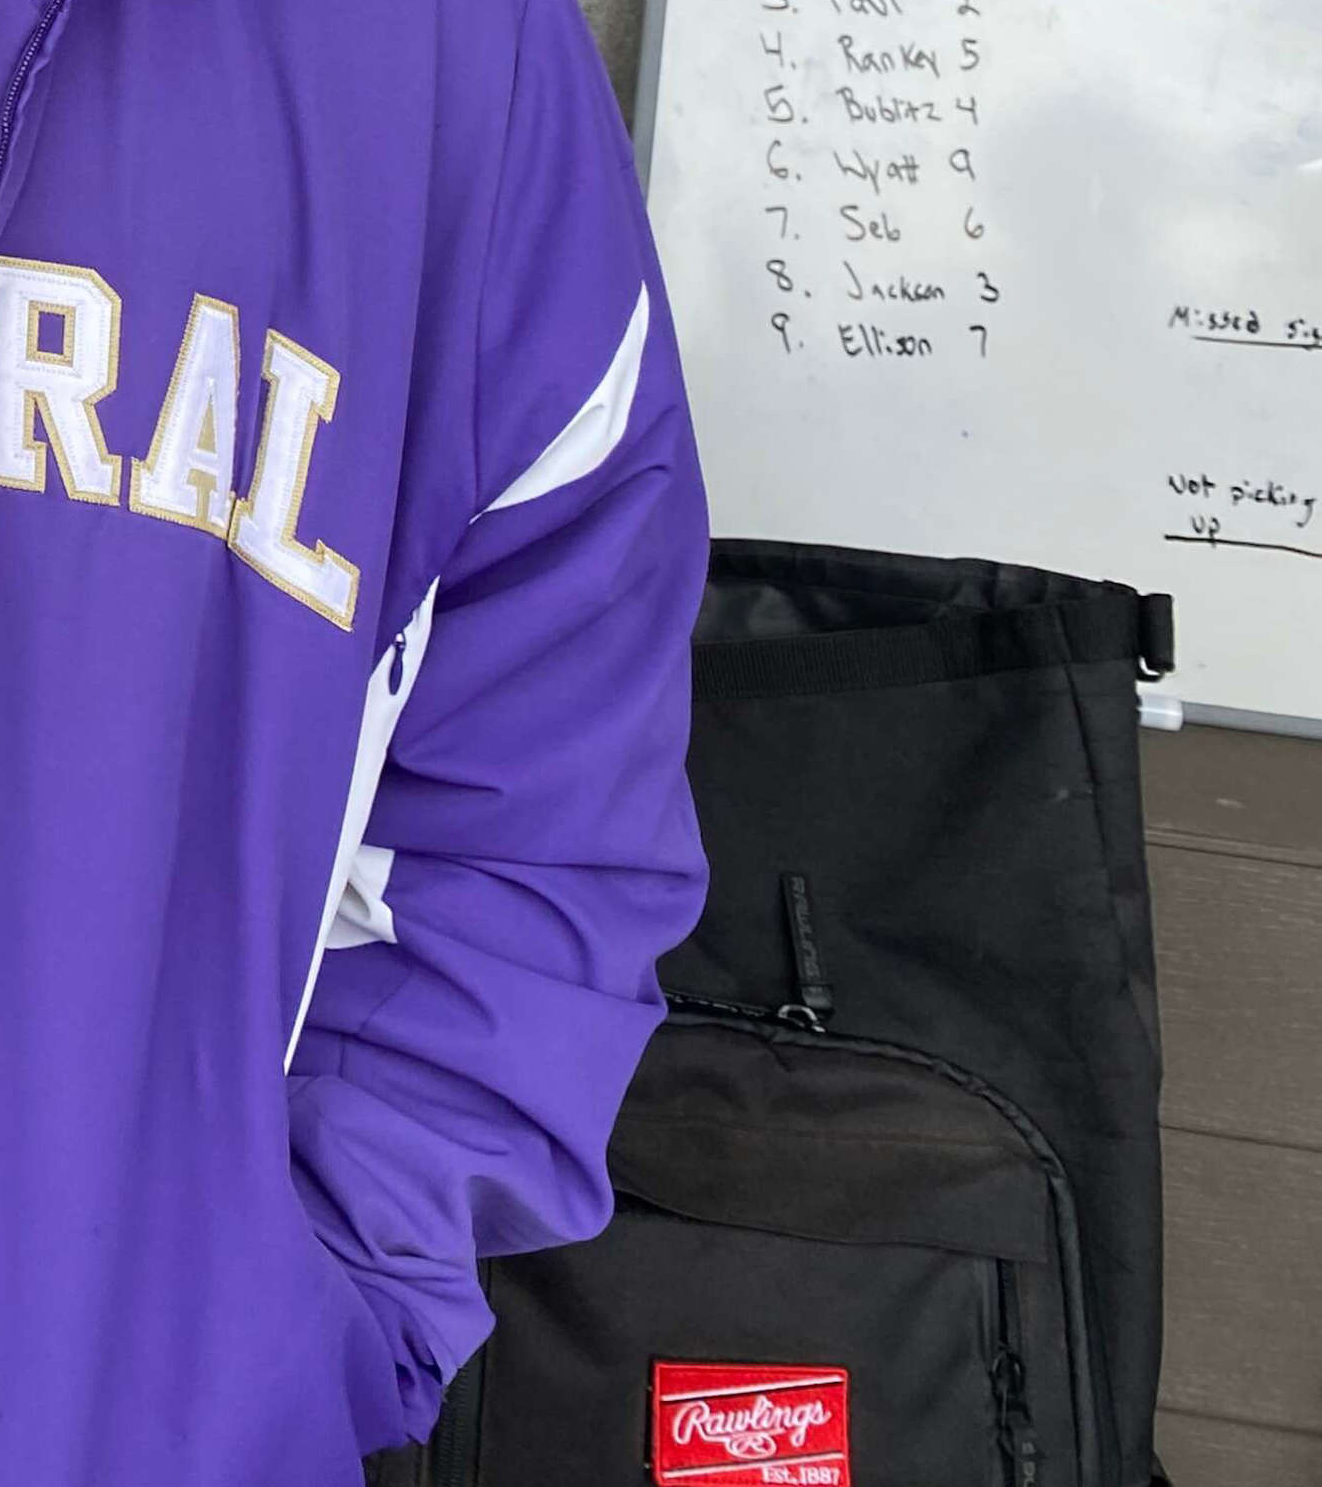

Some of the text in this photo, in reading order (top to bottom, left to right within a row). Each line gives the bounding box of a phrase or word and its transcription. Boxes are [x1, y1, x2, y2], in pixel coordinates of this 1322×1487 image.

[759, 30, 797, 70] 4.
[958, 38, 981, 71] 5
[763, 84, 809, 125] 5.
[954, 95, 979, 126] 4
[766, 139, 977, 196] 6. Wyatt 9
[764, 204, 985, 242] 7. Seb 6
[765, 258, 813, 299] 8.
[976, 271, 1001, 304] 3
[770, 312, 989, 359] 9. Ellison 7
[672, 1394, 832, 1448] Rawlings
